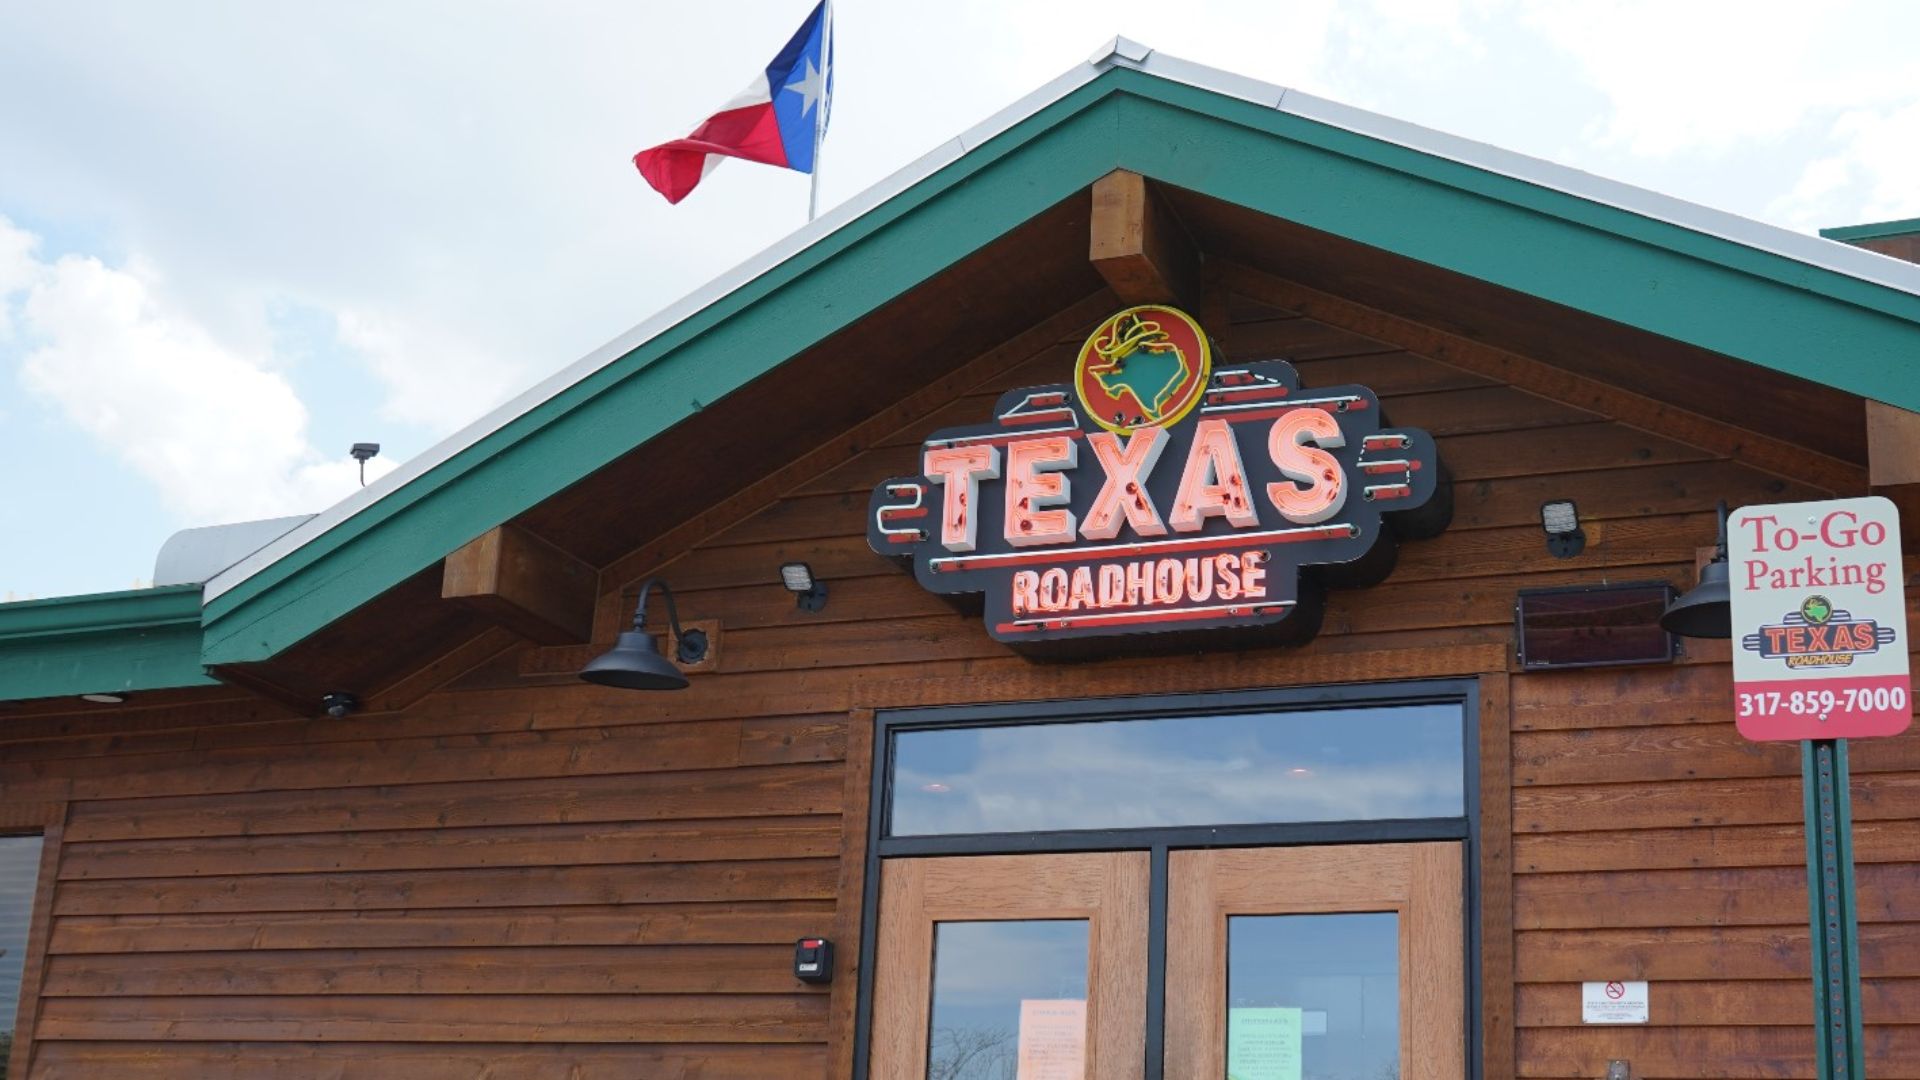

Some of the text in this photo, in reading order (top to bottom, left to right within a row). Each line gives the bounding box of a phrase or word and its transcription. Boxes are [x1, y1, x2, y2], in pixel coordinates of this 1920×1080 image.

[924, 408, 1346, 551] TEXAS
[1740, 511, 1886, 552] To-Go
[1013, 551, 1266, 613] ROADHOUSE
[1745, 556, 1886, 594] Parking
[1766, 625, 1874, 652] TEXAS
[1788, 654, 1852, 666] ROADHOUSE
[1739, 687, 1905, 716] 317-859-7000
